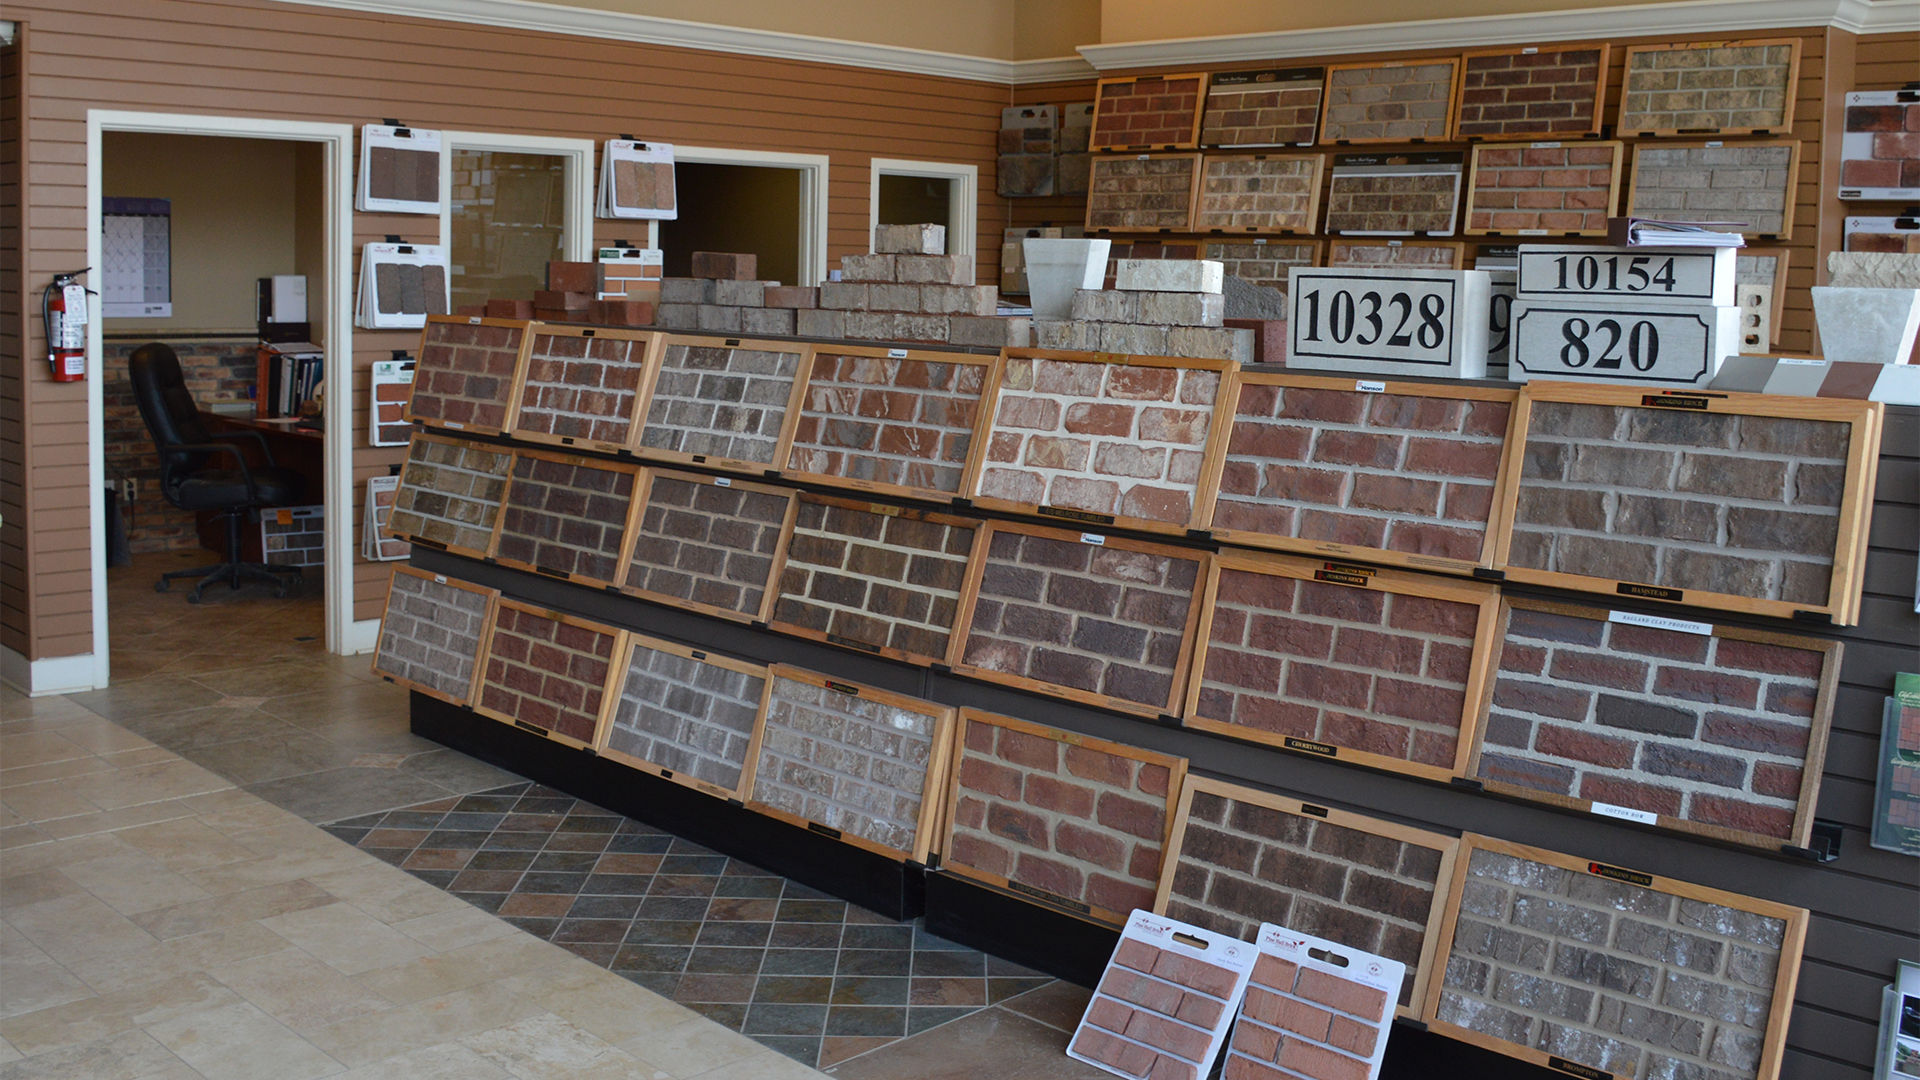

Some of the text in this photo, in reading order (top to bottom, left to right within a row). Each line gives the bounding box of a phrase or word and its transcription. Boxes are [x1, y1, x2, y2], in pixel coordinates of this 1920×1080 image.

[1553, 256, 1676, 292] 10154
[1302, 289, 1445, 349] 10328
[1560, 318, 1659, 371] 820
[1326, 573, 1364, 584] JENKINS BRICK
[1631, 586, 1669, 597] HAMSTEAD
[1623, 615, 1650, 623] RAGLAND
[1668, 621, 1700, 631] PRODUCTS
[1291, 740, 1330, 753] CHERRYWOOD
[1605, 807, 1629, 816] COTTON
[1602, 868, 1650, 885] JENKINS BRICK
[1563, 1062, 1599, 1078] BROMPTON
